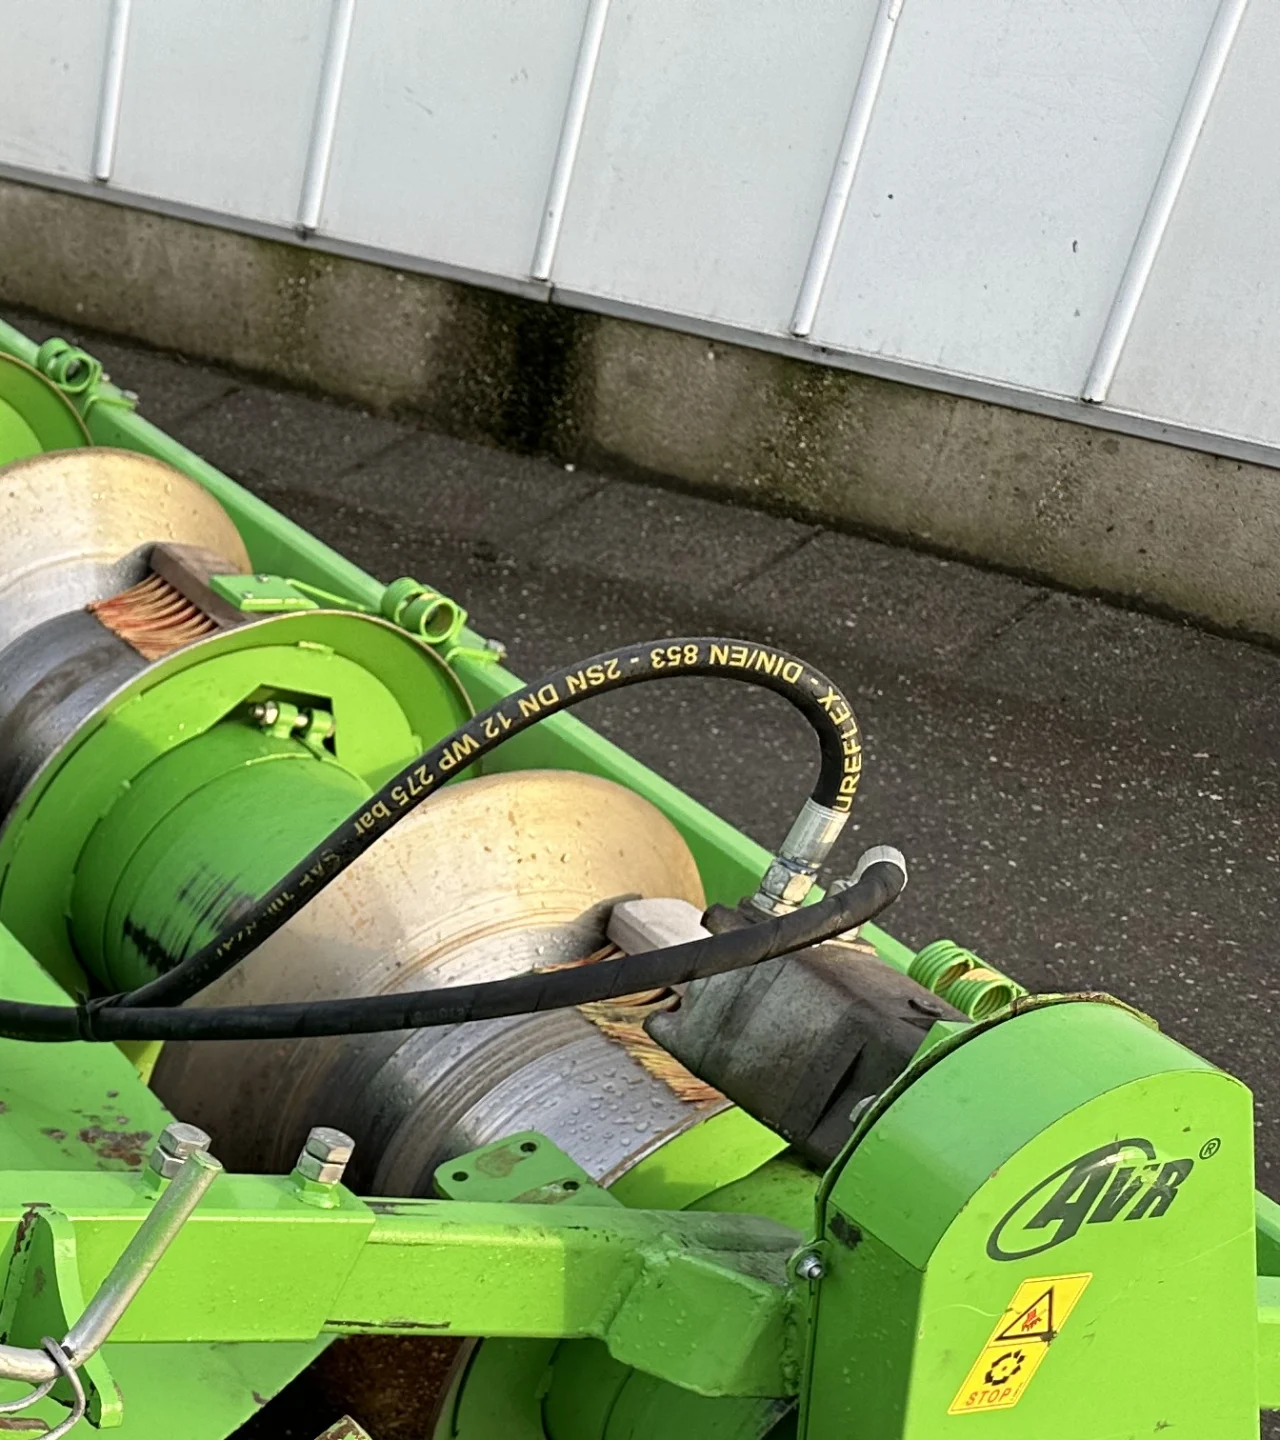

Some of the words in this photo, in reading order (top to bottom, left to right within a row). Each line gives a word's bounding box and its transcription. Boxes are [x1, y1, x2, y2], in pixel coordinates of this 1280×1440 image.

[649, 643, 699, 670] 853
[709, 643, 804, 685] DIN/EN
[565, 657, 622, 695] 2SN
[517, 683, 560, 718] DN
[479, 711, 513, 739] 12
[438, 733, 481, 772] WP
[390, 763, 435, 807] 275
[353, 800, 391, 836] bar
[985, 1137, 1195, 1262] AVR
[965, 1387, 1012, 1406] STOP
